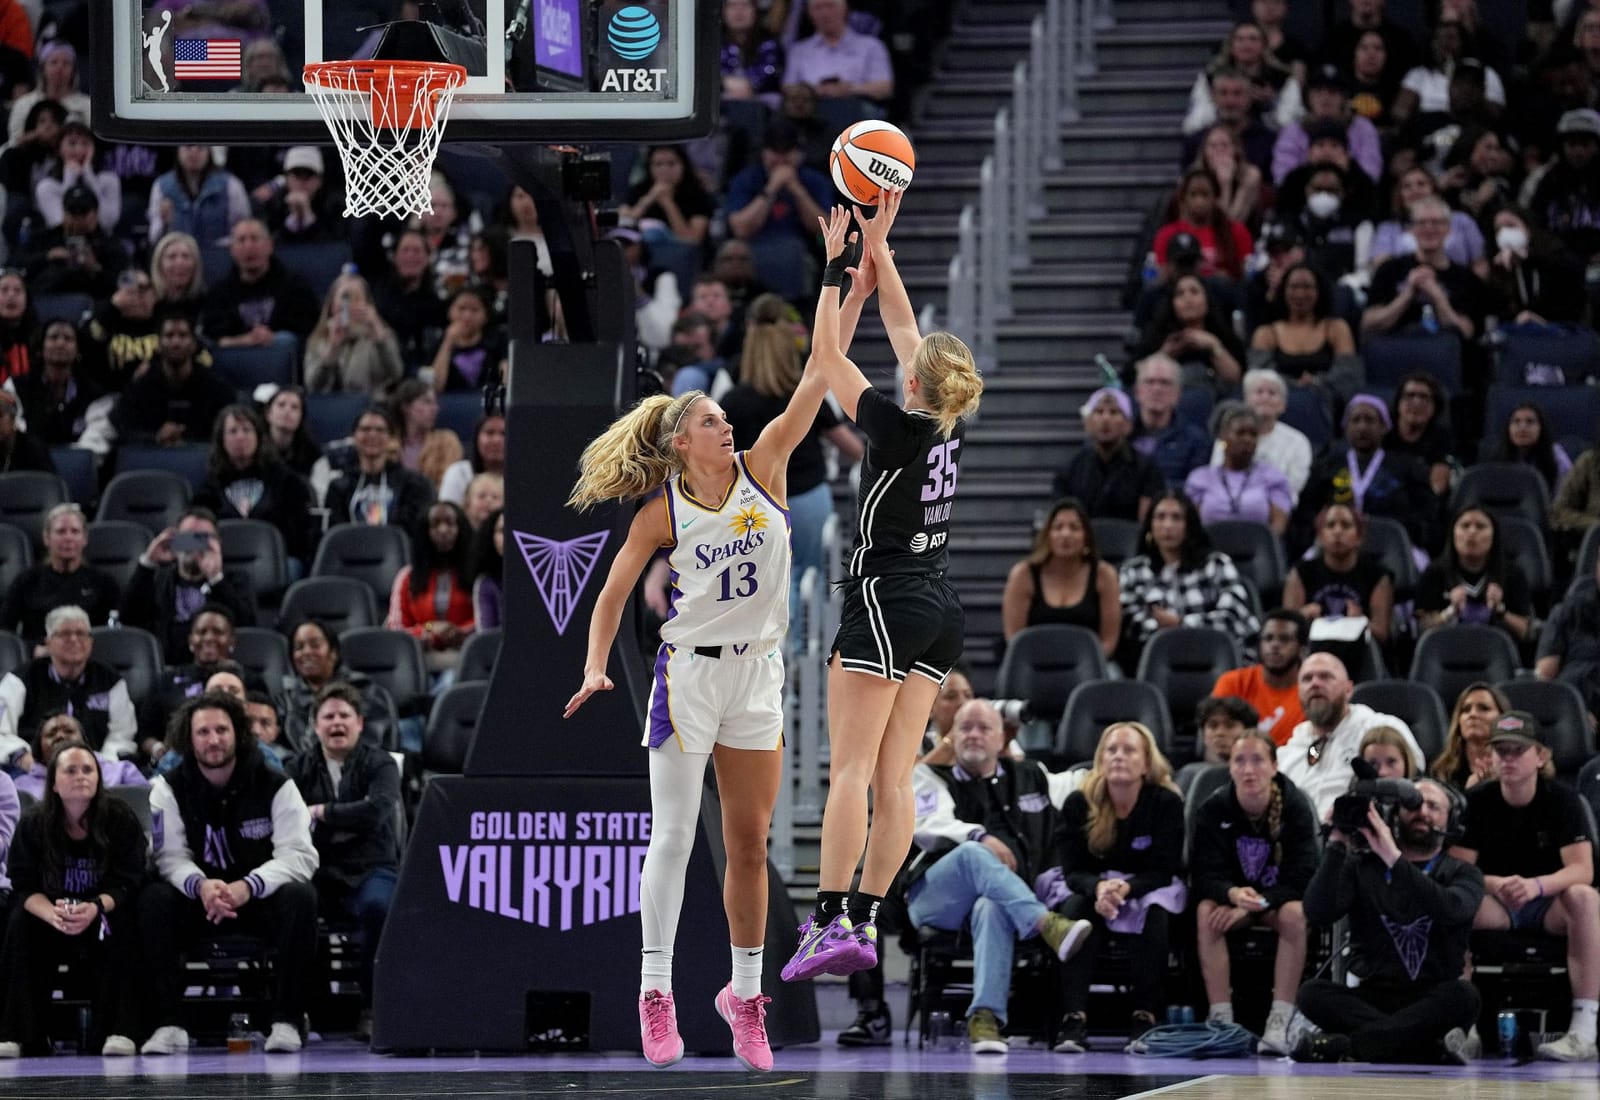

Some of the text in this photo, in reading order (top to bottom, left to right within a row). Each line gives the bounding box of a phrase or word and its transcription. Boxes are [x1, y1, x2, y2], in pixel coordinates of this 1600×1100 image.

[601, 69, 667, 91] AT&T
[868, 157, 909, 189] Wilson
[920, 439, 960, 502] 35
[716, 562, 758, 602] 13
[470, 811, 651, 840] GOLDEN STATE
[438, 845, 650, 931] VALKYRIE
